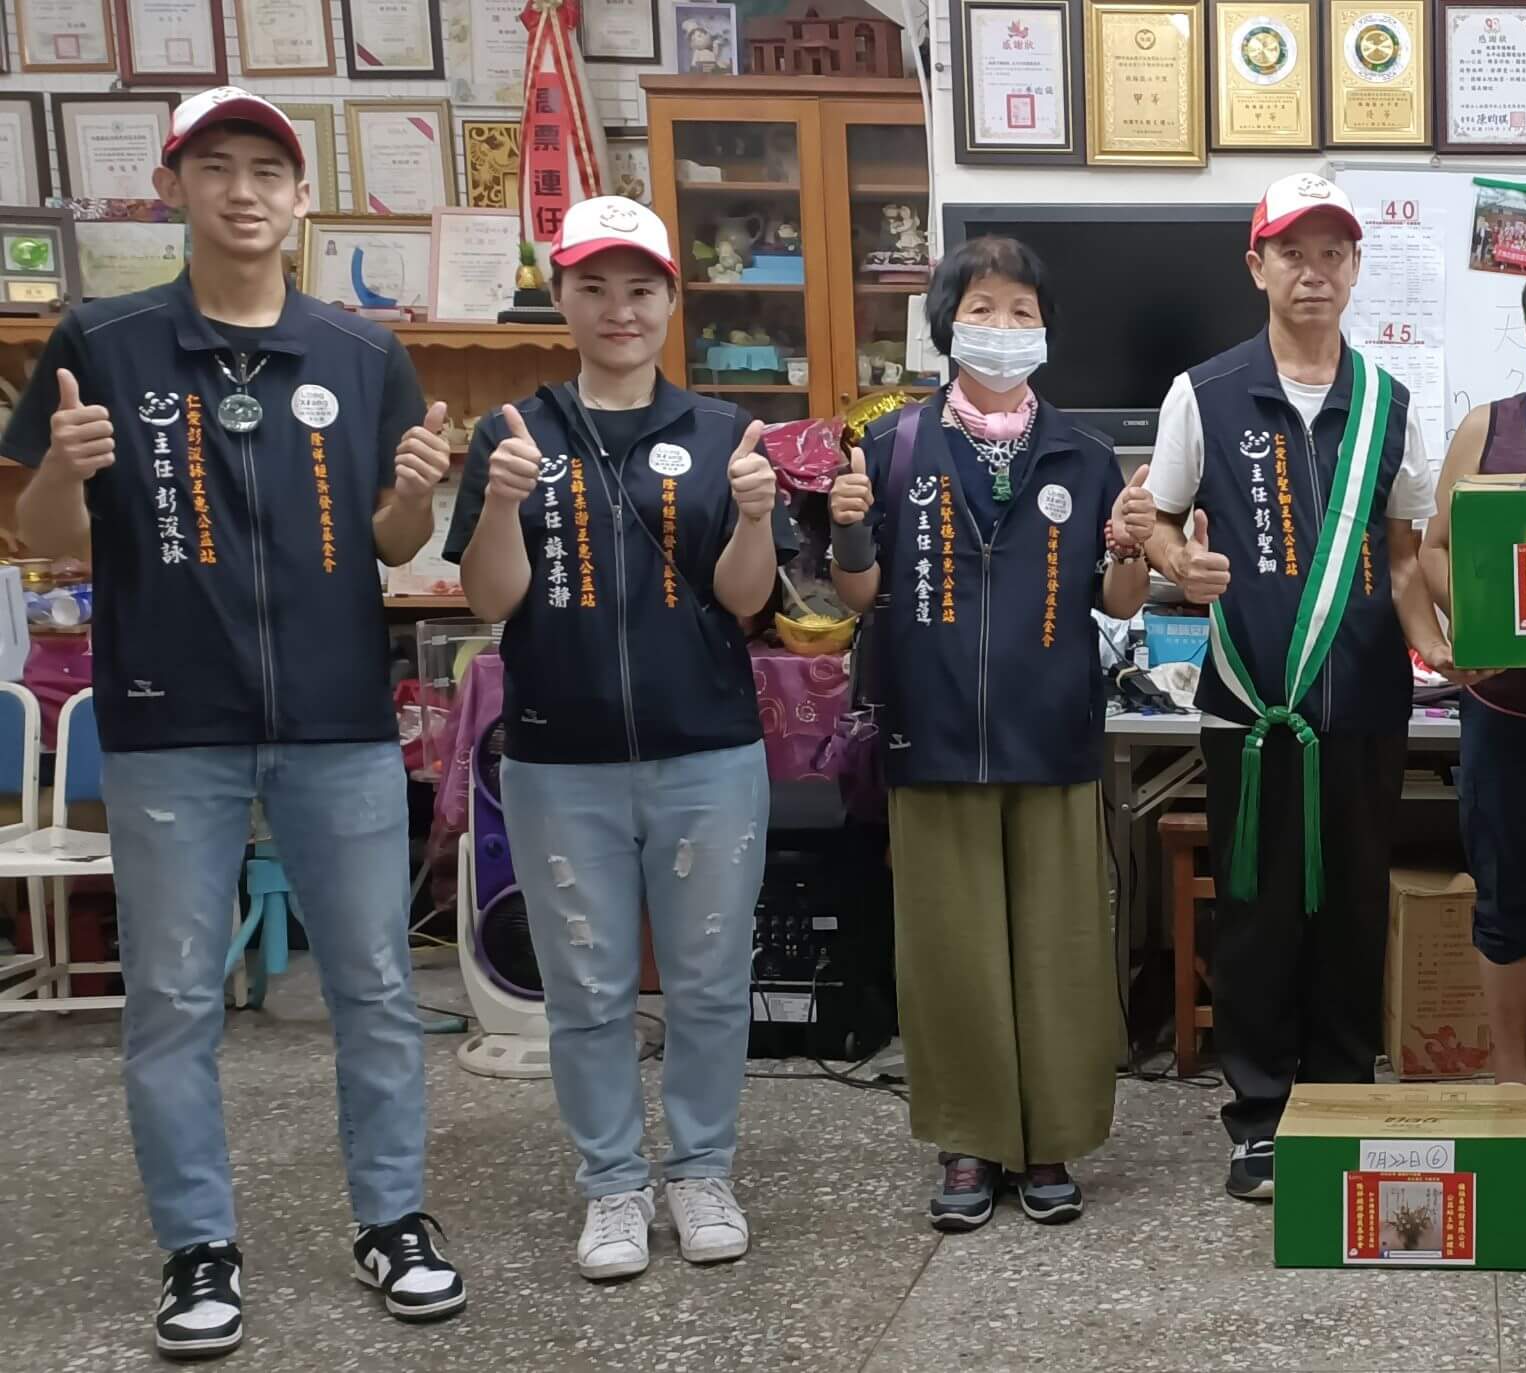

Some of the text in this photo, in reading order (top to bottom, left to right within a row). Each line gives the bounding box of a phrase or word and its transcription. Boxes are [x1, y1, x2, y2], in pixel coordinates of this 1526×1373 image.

[1385, 200, 1415, 220] 40
[1383, 323, 1412, 342] 45
[1367, 1150, 1421, 1169] 7月22日
